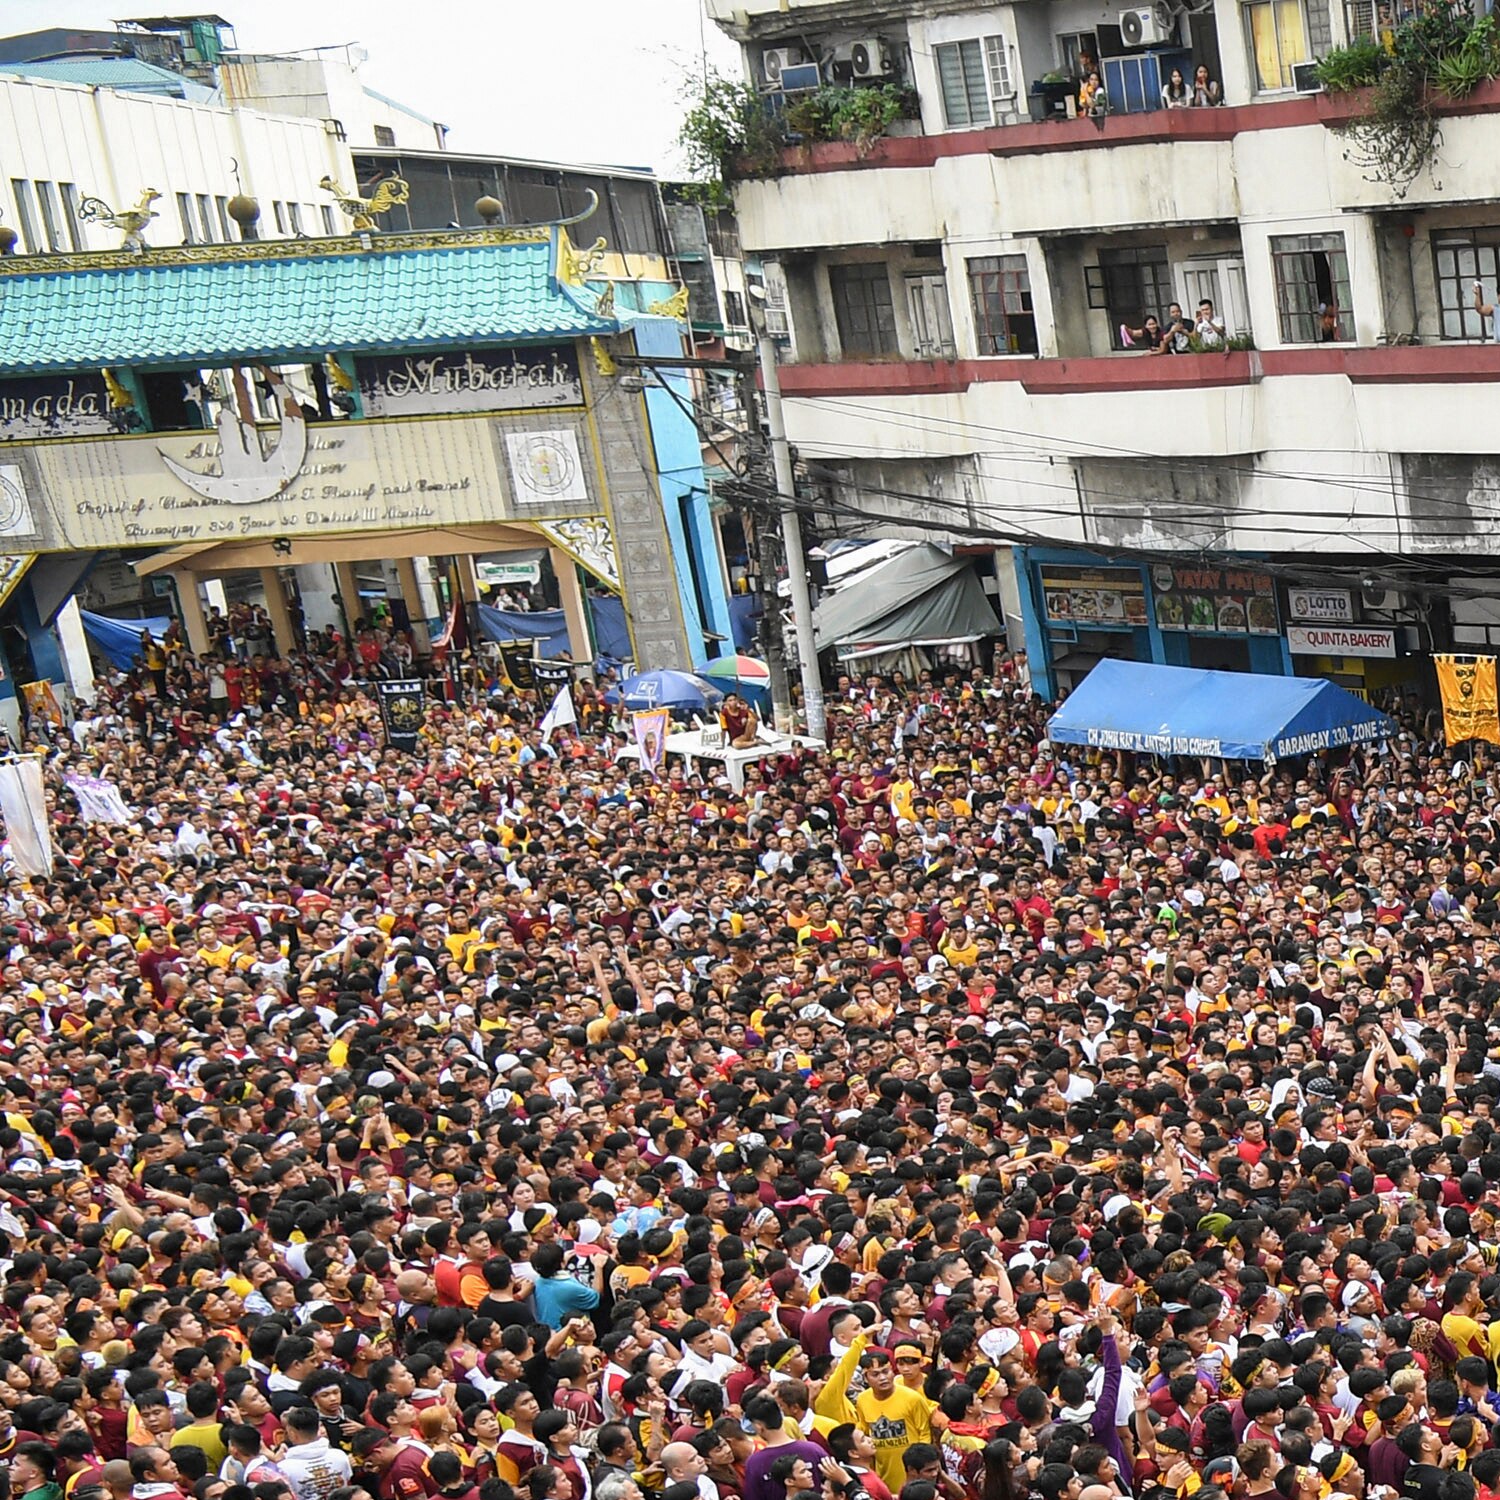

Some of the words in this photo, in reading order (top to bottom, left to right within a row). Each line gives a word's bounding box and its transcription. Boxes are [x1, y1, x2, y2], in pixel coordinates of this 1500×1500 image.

[387, 352, 568, 398] Mubarak
[362, 508, 377, 522] III
[1309, 598, 1346, 610] LOTTO
[1307, 632, 1349, 647] QUINTA
[1350, 634, 1391, 648] BAKERY
[1173, 737, 1188, 754] AND
[1190, 738, 1222, 756] COUNCIL
[1278, 733, 1329, 756] BARANGAY
[1353, 722, 1377, 740] ZONE
